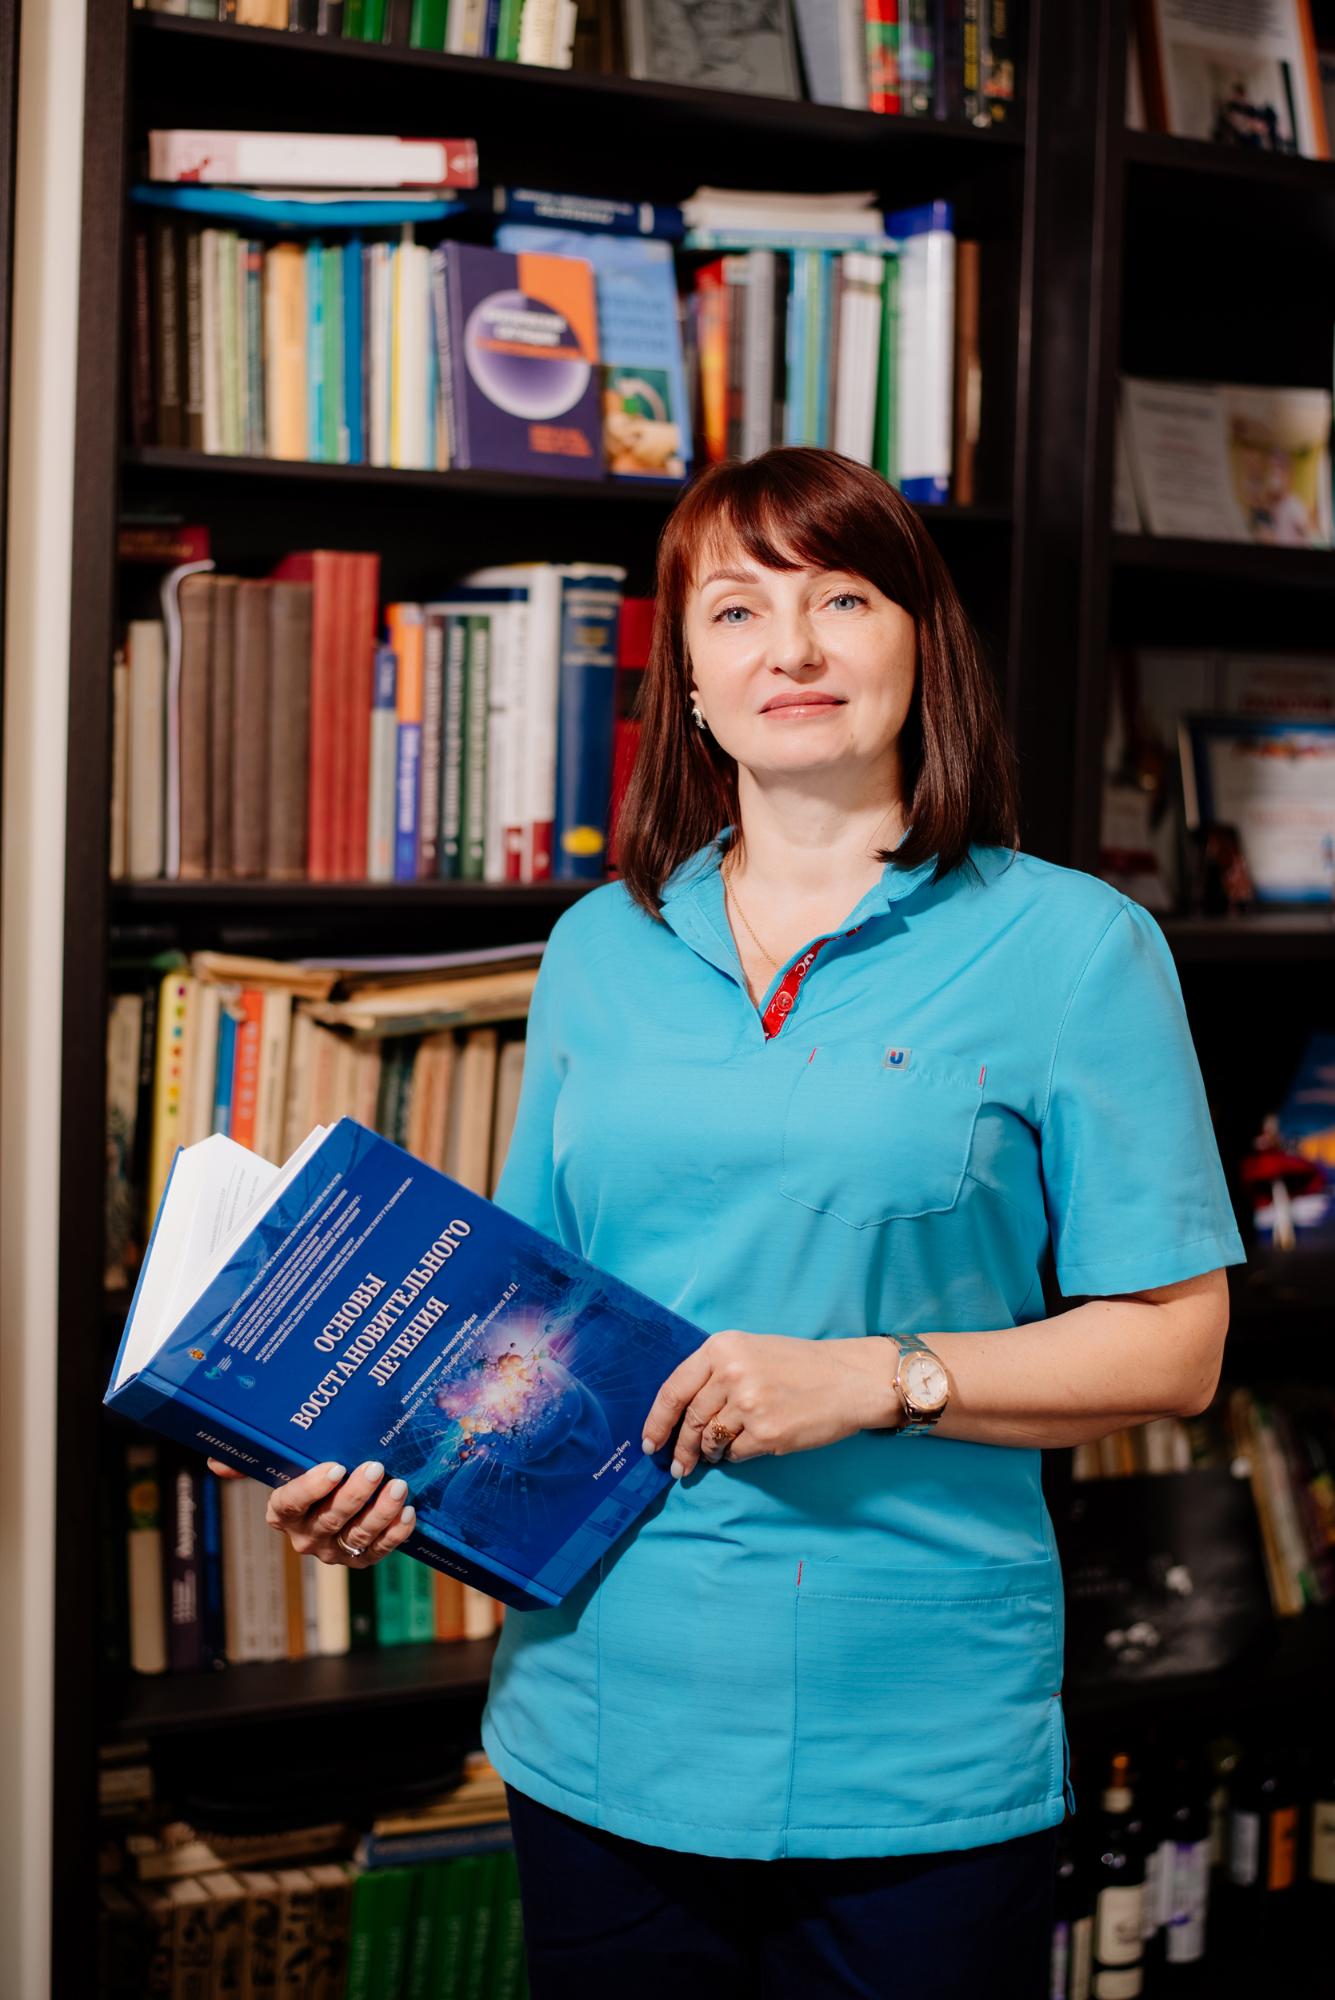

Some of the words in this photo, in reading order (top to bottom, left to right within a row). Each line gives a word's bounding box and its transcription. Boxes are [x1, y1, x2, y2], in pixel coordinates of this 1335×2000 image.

[288, 1218, 473, 1431] ВОССТАНОВИТЕЛЬНОГО
[313, 1272, 388, 1353] ОСНОВЫ
[366, 1295, 450, 1388] ЛЕЧЕНИЯ
[378, 1429, 396, 1446] Под
[390, 1396, 424, 1433] редакцией
[438, 1336, 475, 1376] профессора
[469, 1298, 506, 1338] Терентьева
[501, 1280, 521, 1300] В.П.
[398, 1354, 443, 1404] коллективная
[439, 1312, 479, 1357] монография
[196, 1429, 260, 1467] ЛЕЧЕНИЯ
[591, 1439, 632, 1480] Ростов-на-Дону
[612, 1456, 627, 1472] 2015
